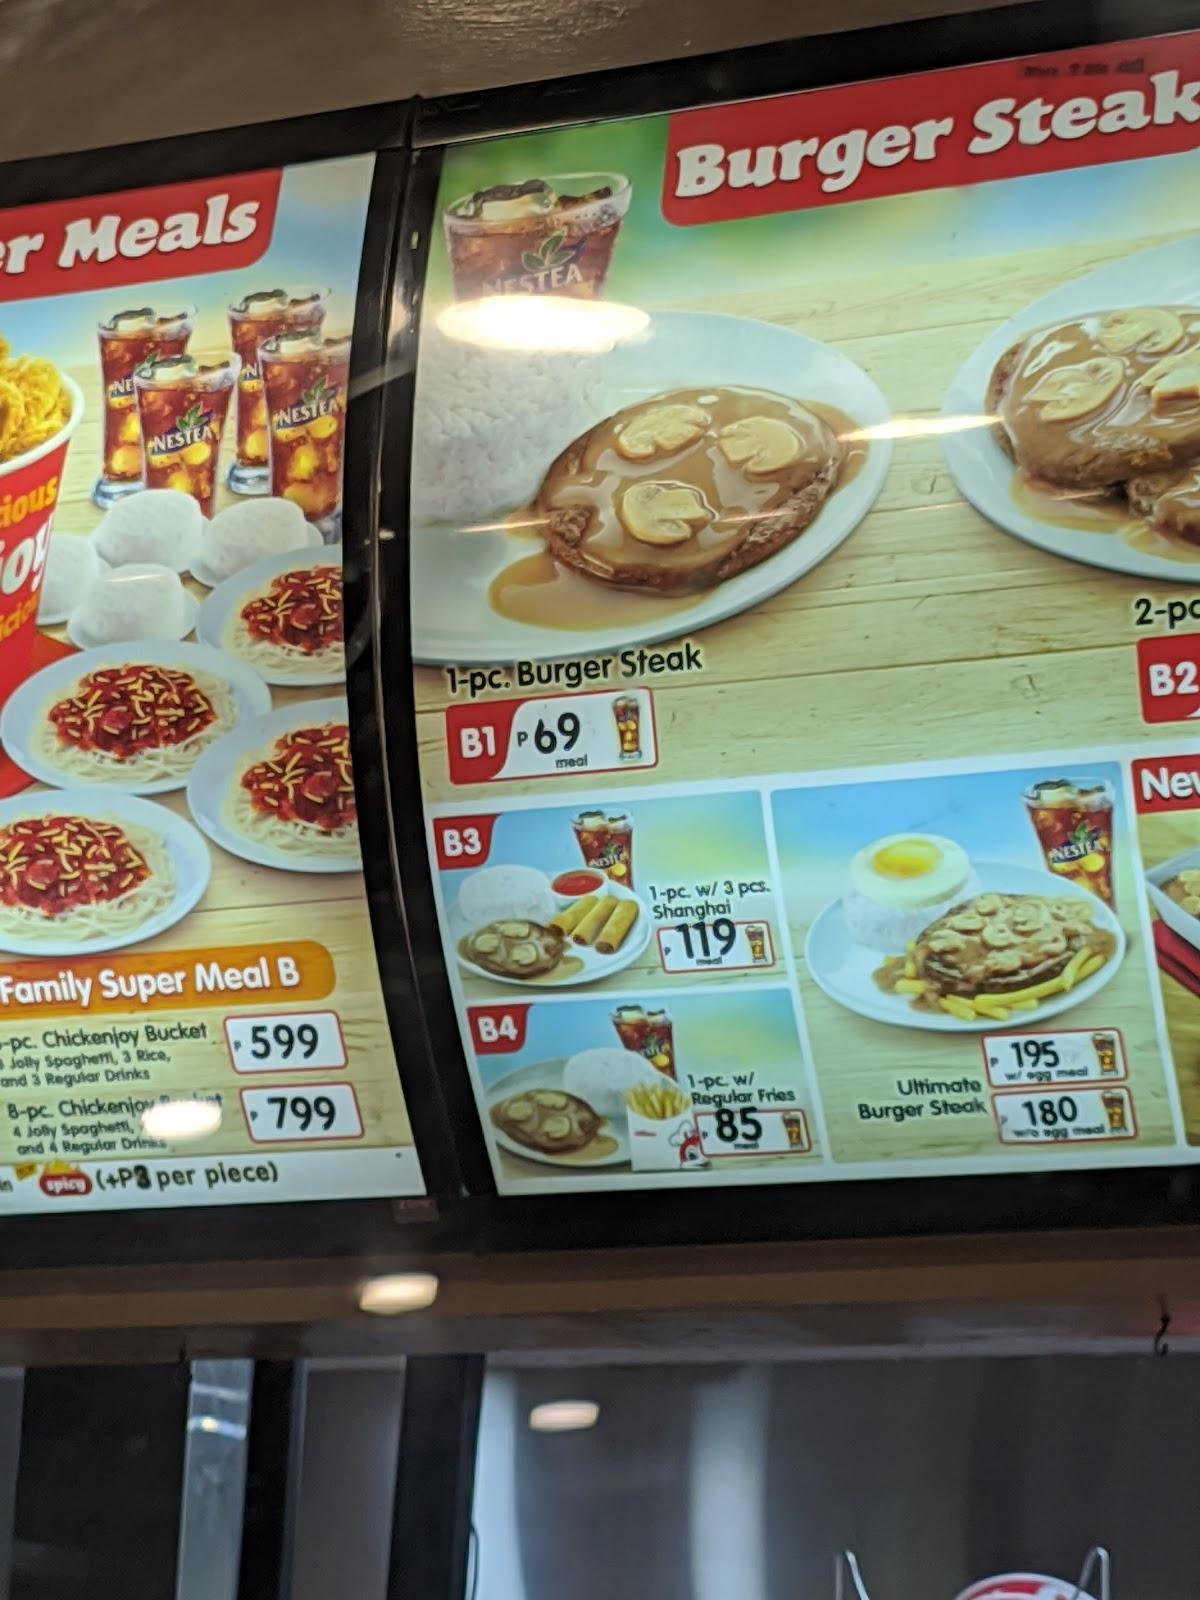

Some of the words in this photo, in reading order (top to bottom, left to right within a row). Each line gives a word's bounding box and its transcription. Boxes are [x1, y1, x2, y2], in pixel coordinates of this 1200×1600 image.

[675, 116, 953, 197] Burger
[0, 233, 44, 273] r
[57, 193, 260, 268] Meals
[278, 397, 341, 426] NESTEA
[152, 425, 213, 452] NESTEA
[446, 667, 511, 698] 1-pc.
[516, 660, 612, 688] Burger
[621, 643, 703, 678] Steak
[1149, 660, 1200, 696] B2
[460, 725, 496, 759] B1
[534, 711, 581, 755] 69
[555, 754, 589, 769] meal
[443, 827, 482, 857] B3
[696, 881, 719, 897] w/
[723, 880, 735, 896] 3
[738, 879, 772, 899] pcs.
[653, 899, 732, 920] Shanghai
[675, 917, 737, 960] 119
[0, 970, 92, 1008] Family
[98, 968, 187, 1004] Super
[194, 956, 271, 993] Meal
[277, 956, 300, 988] B
[0, 1036, 38, 1054] -pc.
[42, 1027, 140, 1049] Chickenjoy
[144, 1022, 207, 1042] Bucket
[251, 1023, 319, 1060] 599
[477, 1015, 519, 1042] B4
[10, 1057, 40, 1071] Jolly
[122, 1050, 131, 1063] 3
[136, 1048, 171, 1063] Rice,
[1011, 1040, 1061, 1069] 195
[0, 1073, 28, 1087] and
[45, 1072, 101, 1088] Regular
[104, 1068, 150, 1082] Drinks
[733, 1071, 755, 1086] w/
[897, 1077, 982, 1097] Ultimate
[1005, 1070, 1022, 1081] w/
[1026, 1069, 1052, 1082] egg
[1056, 1066, 1088, 1078] meal
[691, 1089, 754, 1109] Regular
[758, 1087, 797, 1103] Fries
[858, 1101, 924, 1123] Burger
[929, 1098, 988, 1116] Steak
[1022, 1095, 1078, 1127] 180
[267, 1095, 337, 1132] 799
[714, 1106, 763, 1143] 85
[17, 1142, 45, 1155] and
[49, 1141, 58, 1153] 4
[62, 1139, 116, 1155] Regular
[121, 1136, 168, 1151] Drinks
[27, 1125, 57, 1140] Jolly
[1043, 1128, 1069, 1141] egg
[1071, 1124, 1106, 1137] meal
[46, 1176, 86, 1194] spicy
[156, 1169, 196, 1191] per
[204, 1160, 279, 1188] piece)
